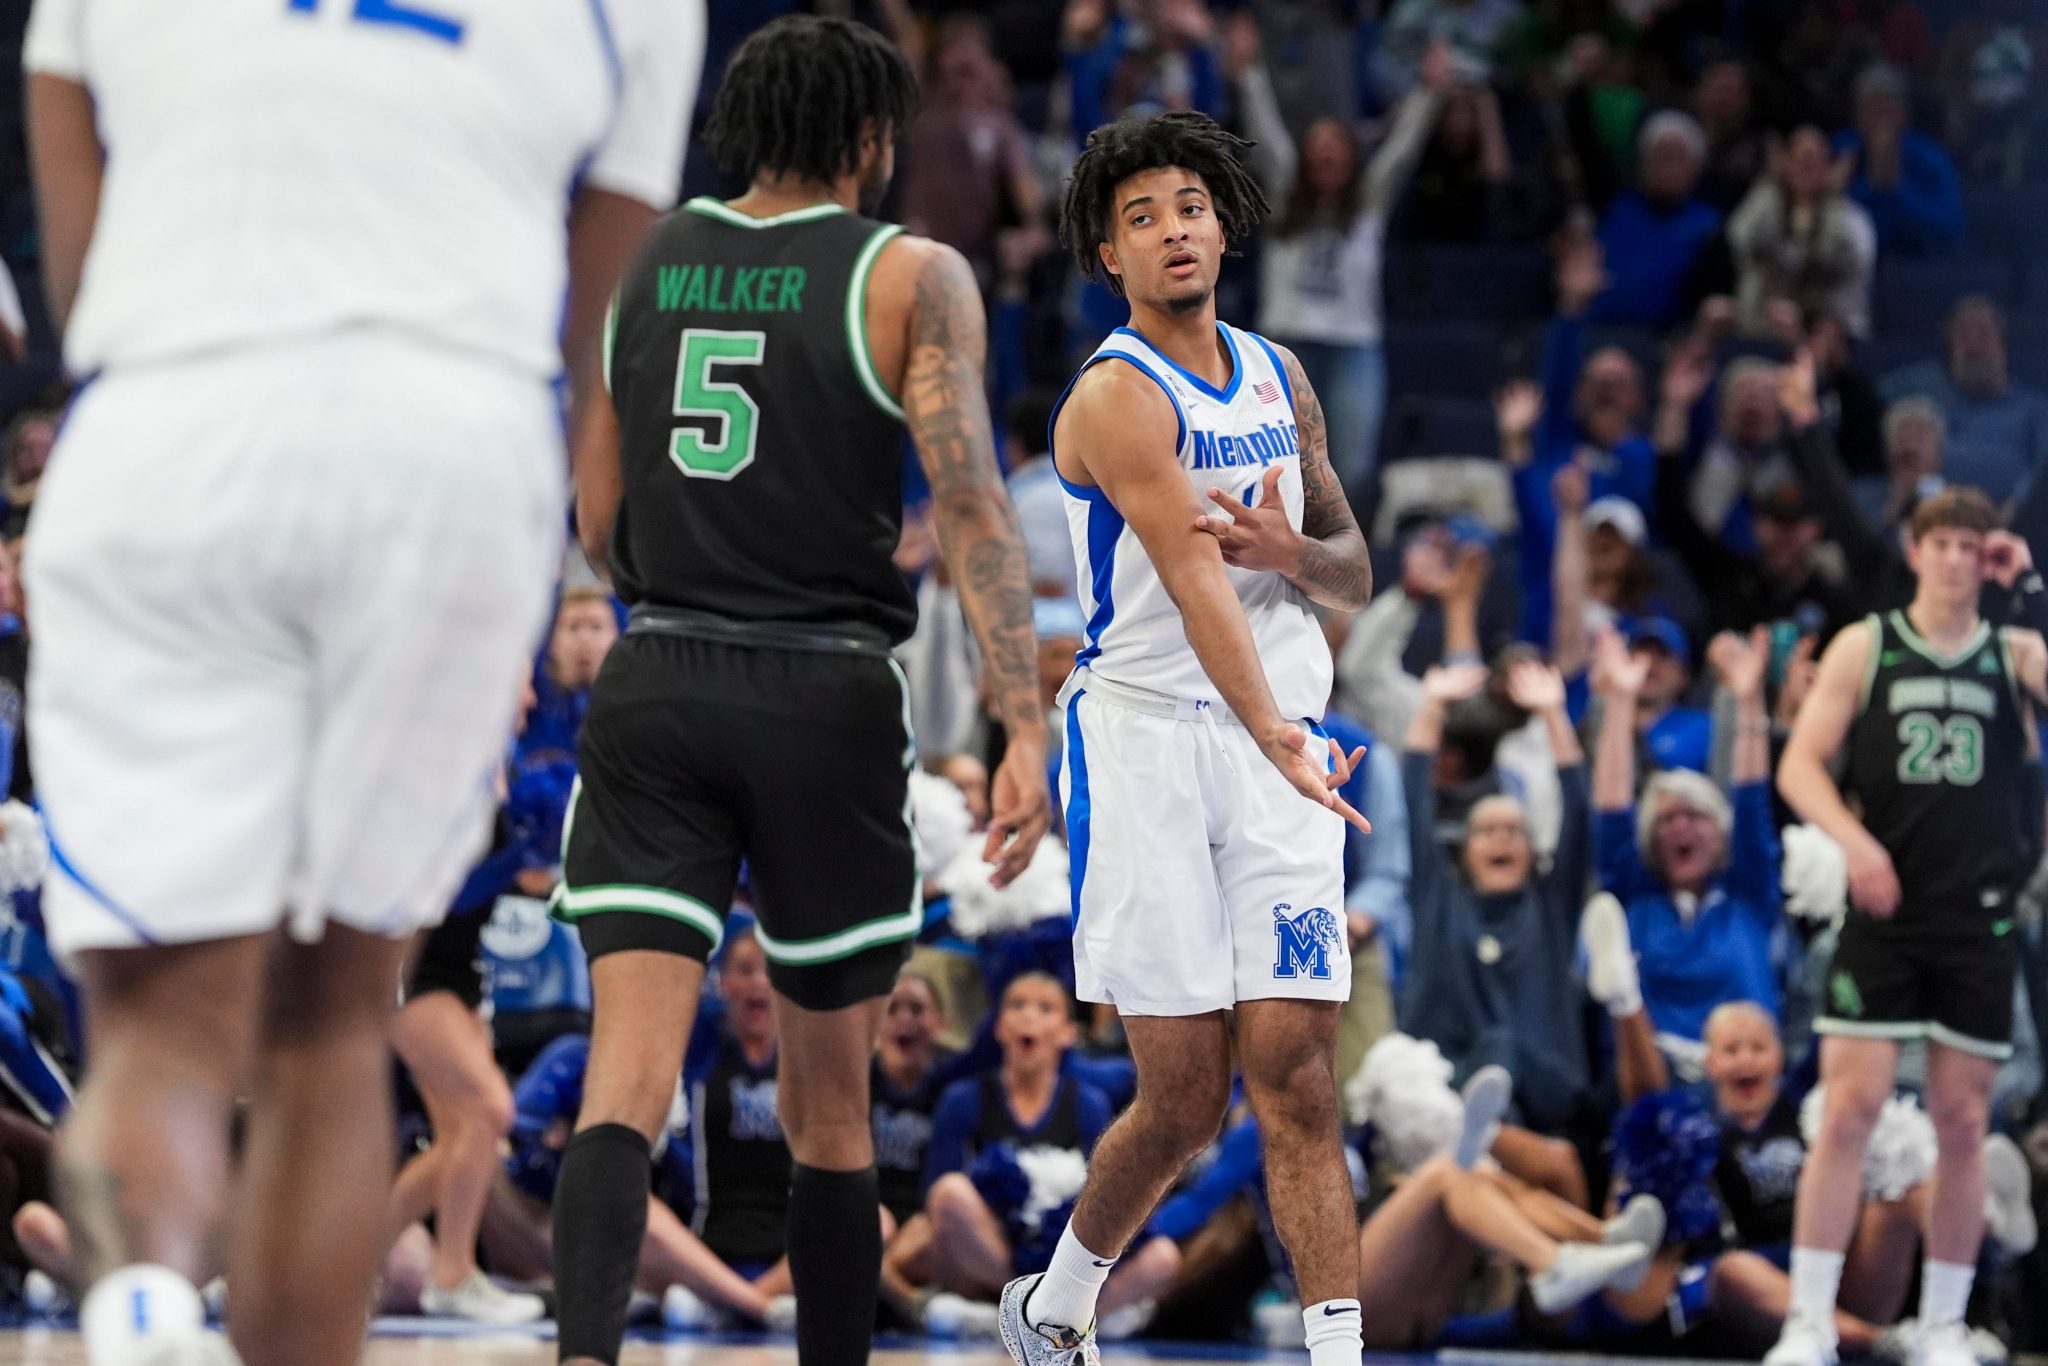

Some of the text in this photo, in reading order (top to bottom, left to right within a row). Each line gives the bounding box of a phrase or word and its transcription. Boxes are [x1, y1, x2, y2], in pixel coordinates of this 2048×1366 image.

[657, 264, 808, 313] WALKER
[669, 328, 766, 481] 5
[1190, 419, 1299, 470] Memphis
[1897, 711, 1985, 786] 23
[1273, 920, 1331, 979] M
